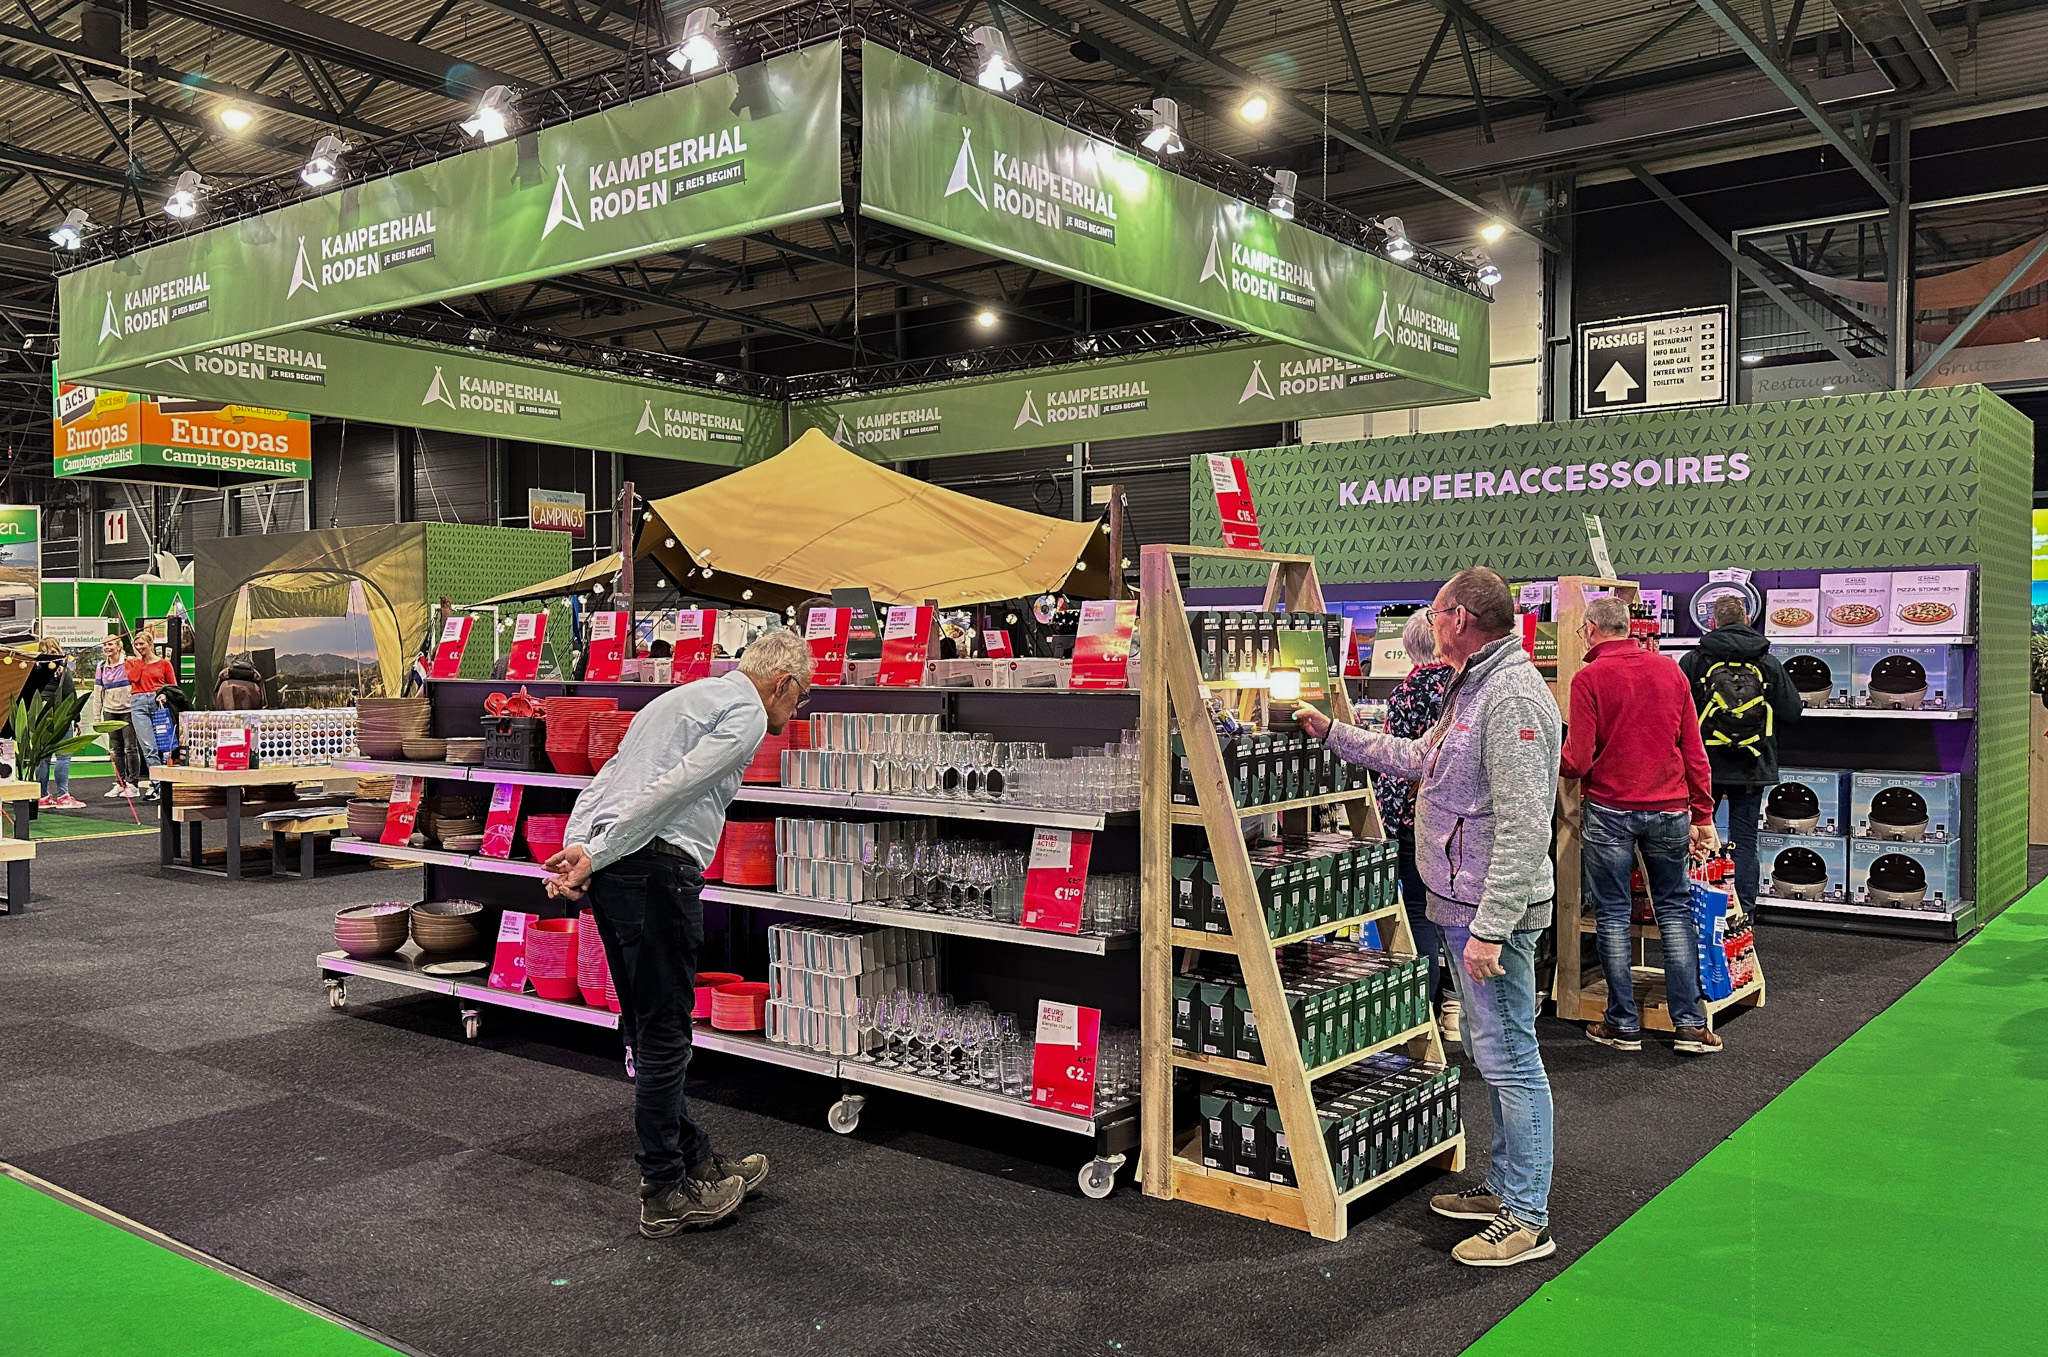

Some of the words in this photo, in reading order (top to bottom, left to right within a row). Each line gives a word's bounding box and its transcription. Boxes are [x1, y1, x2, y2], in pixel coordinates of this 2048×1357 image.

[589, 125, 748, 192] KAMPEERHAL
[674, 182, 685, 195] JE
[686, 176, 705, 190] REIS
[706, 165, 741, 185] BEGINT!
[993, 150, 1117, 220] KAMPEERHAL
[590, 178, 667, 223] RODEN
[993, 182, 1060, 230] RODEN
[321, 210, 436, 260] KAMPEERHAL
[1065, 216, 1073, 227] JE
[1074, 218, 1088, 231] REIS
[321, 251, 380, 286] RODEN
[383, 255, 391, 266] JE
[391, 251, 406, 262] REIS
[1231, 242, 1316, 292] KAMPEERHAL
[124, 271, 211, 312] KAMPEERHAL
[1231, 267, 1278, 303] RODEN
[124, 306, 168, 335] RODEN
[1397, 303, 1461, 341] KAMPEERHAL
[1653, 329, 1666, 337] HAL
[1669, 325, 1693, 335] 1-2-3-4
[1396, 325, 1431, 353] RODEN
[1589, 331, 1645, 350] PASSAGE
[1653, 336, 1693, 347] RESTAURANT
[1653, 349, 1668, 357] INFO
[1653, 358, 1675, 367] GRAND
[194, 354, 264, 380] RODEN
[270, 370, 279, 378] JE
[280, 370, 295, 379] REIS
[1653, 368, 1676, 377] ENTREE
[1677, 366, 1694, 374] WEST
[460, 375, 562, 405] KAMPEERHAL
[1047, 380, 1150, 407] KAMPEERHAL
[1280, 374, 1344, 396] RODEN
[1653, 378, 1685, 387] TOILETTEN
[1757, 373, 1863, 393] Restauran
[65, 387, 88, 411] ACSI
[460, 393, 515, 415] RODEN
[664, 407, 745, 432] KAMPEERHAL
[856, 407, 942, 430] KAMPEERHAL
[1047, 403, 1099, 423] RODEN
[66, 422, 128, 452] Europas
[170, 418, 289, 454] Europas
[664, 423, 707, 441] RODEN
[857, 427, 900, 445] RODEN
[62, 448, 133, 472] Campingspezialist
[162, 448, 297, 474] Campingspezialist
[1339, 452, 1751, 507] KAMPEERACCESSOIRES
[108, 513, 124, 541] 11
[532, 505, 583, 528] CAMPINGS
[1036, 840, 1057, 848] ACTIE!
[1054, 887, 1081, 900] €1.50
[1042, 1006, 1064, 1016] BEURS
[1042, 1014, 1063, 1023] ACTIE!
[1066, 1066, 1092, 1082] €2.-
